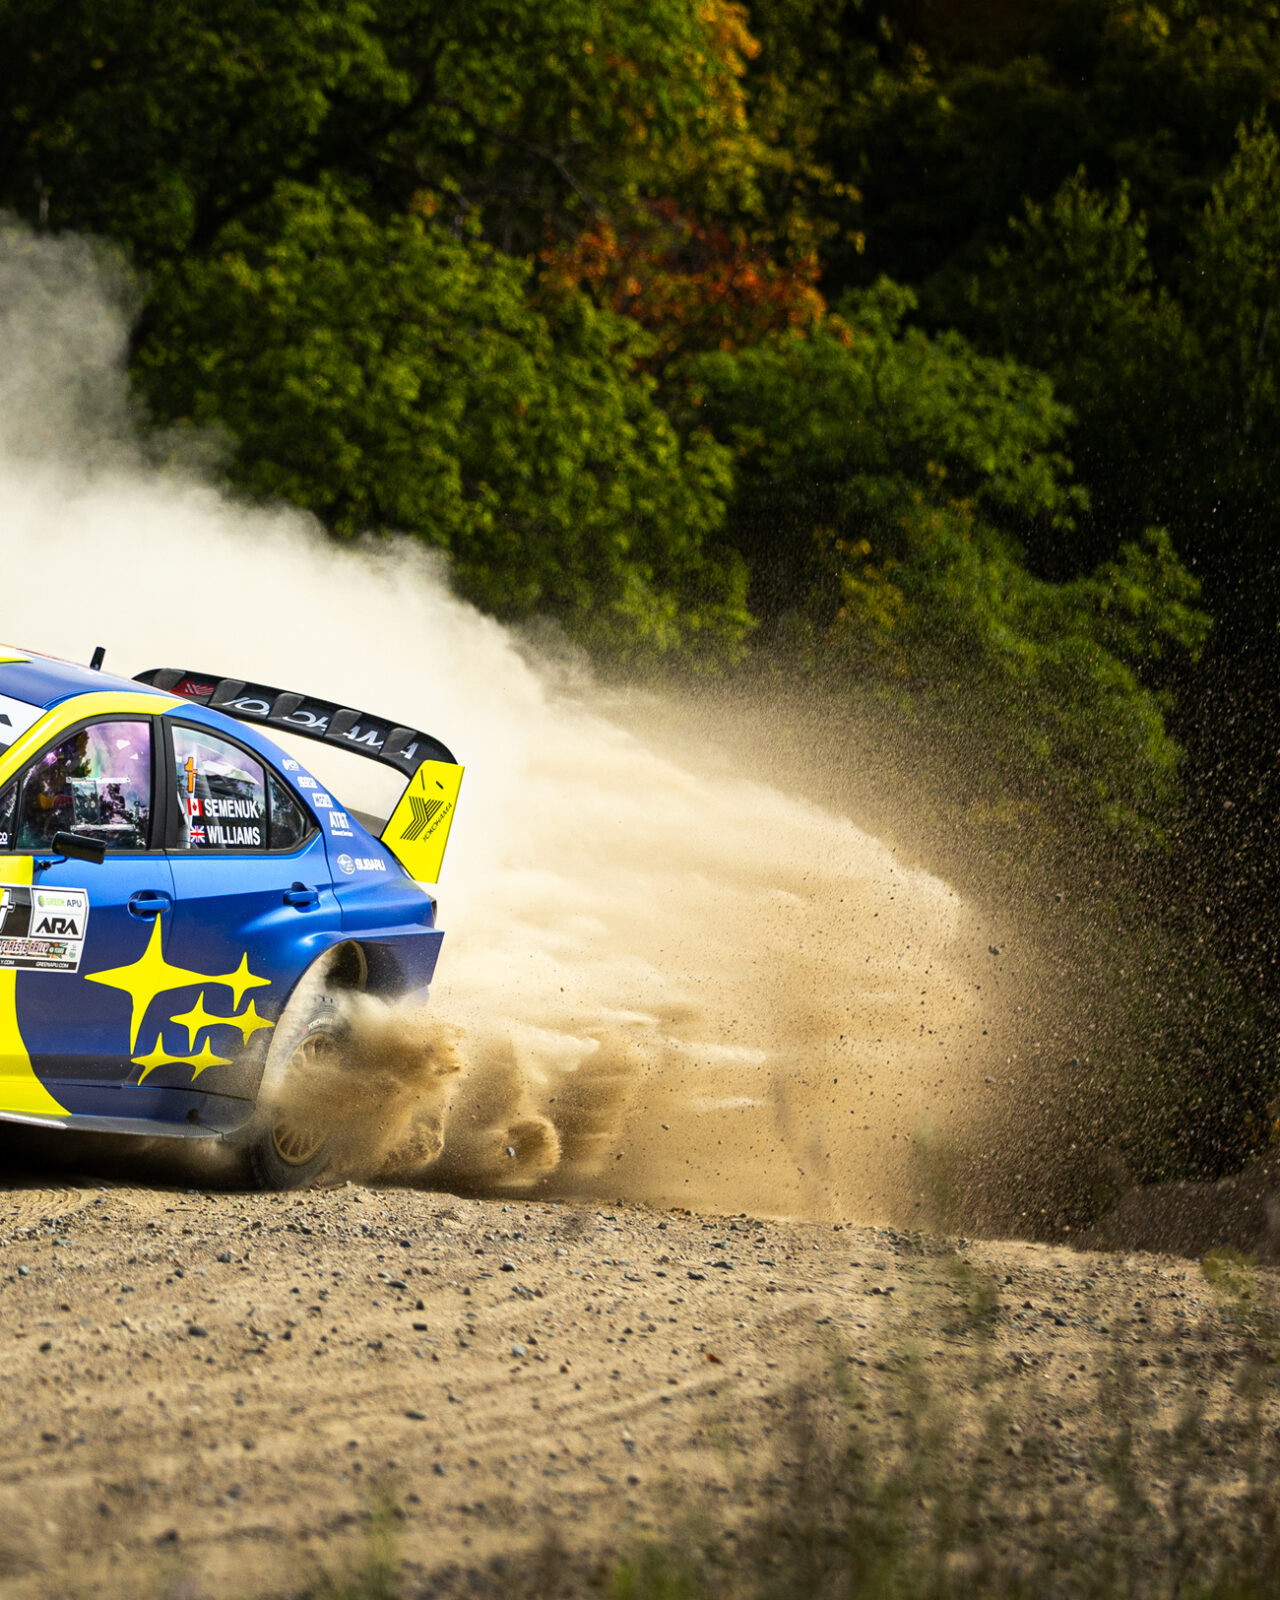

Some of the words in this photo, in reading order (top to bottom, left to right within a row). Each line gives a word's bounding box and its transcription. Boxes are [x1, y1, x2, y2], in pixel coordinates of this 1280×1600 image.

[204, 800, 260, 819] SEMENUK
[206, 826, 261, 846] WILLIAMS
[354, 858, 386, 871] SUBARU
[66, 899, 82, 908] APU
[35, 917, 79, 936] ARA
